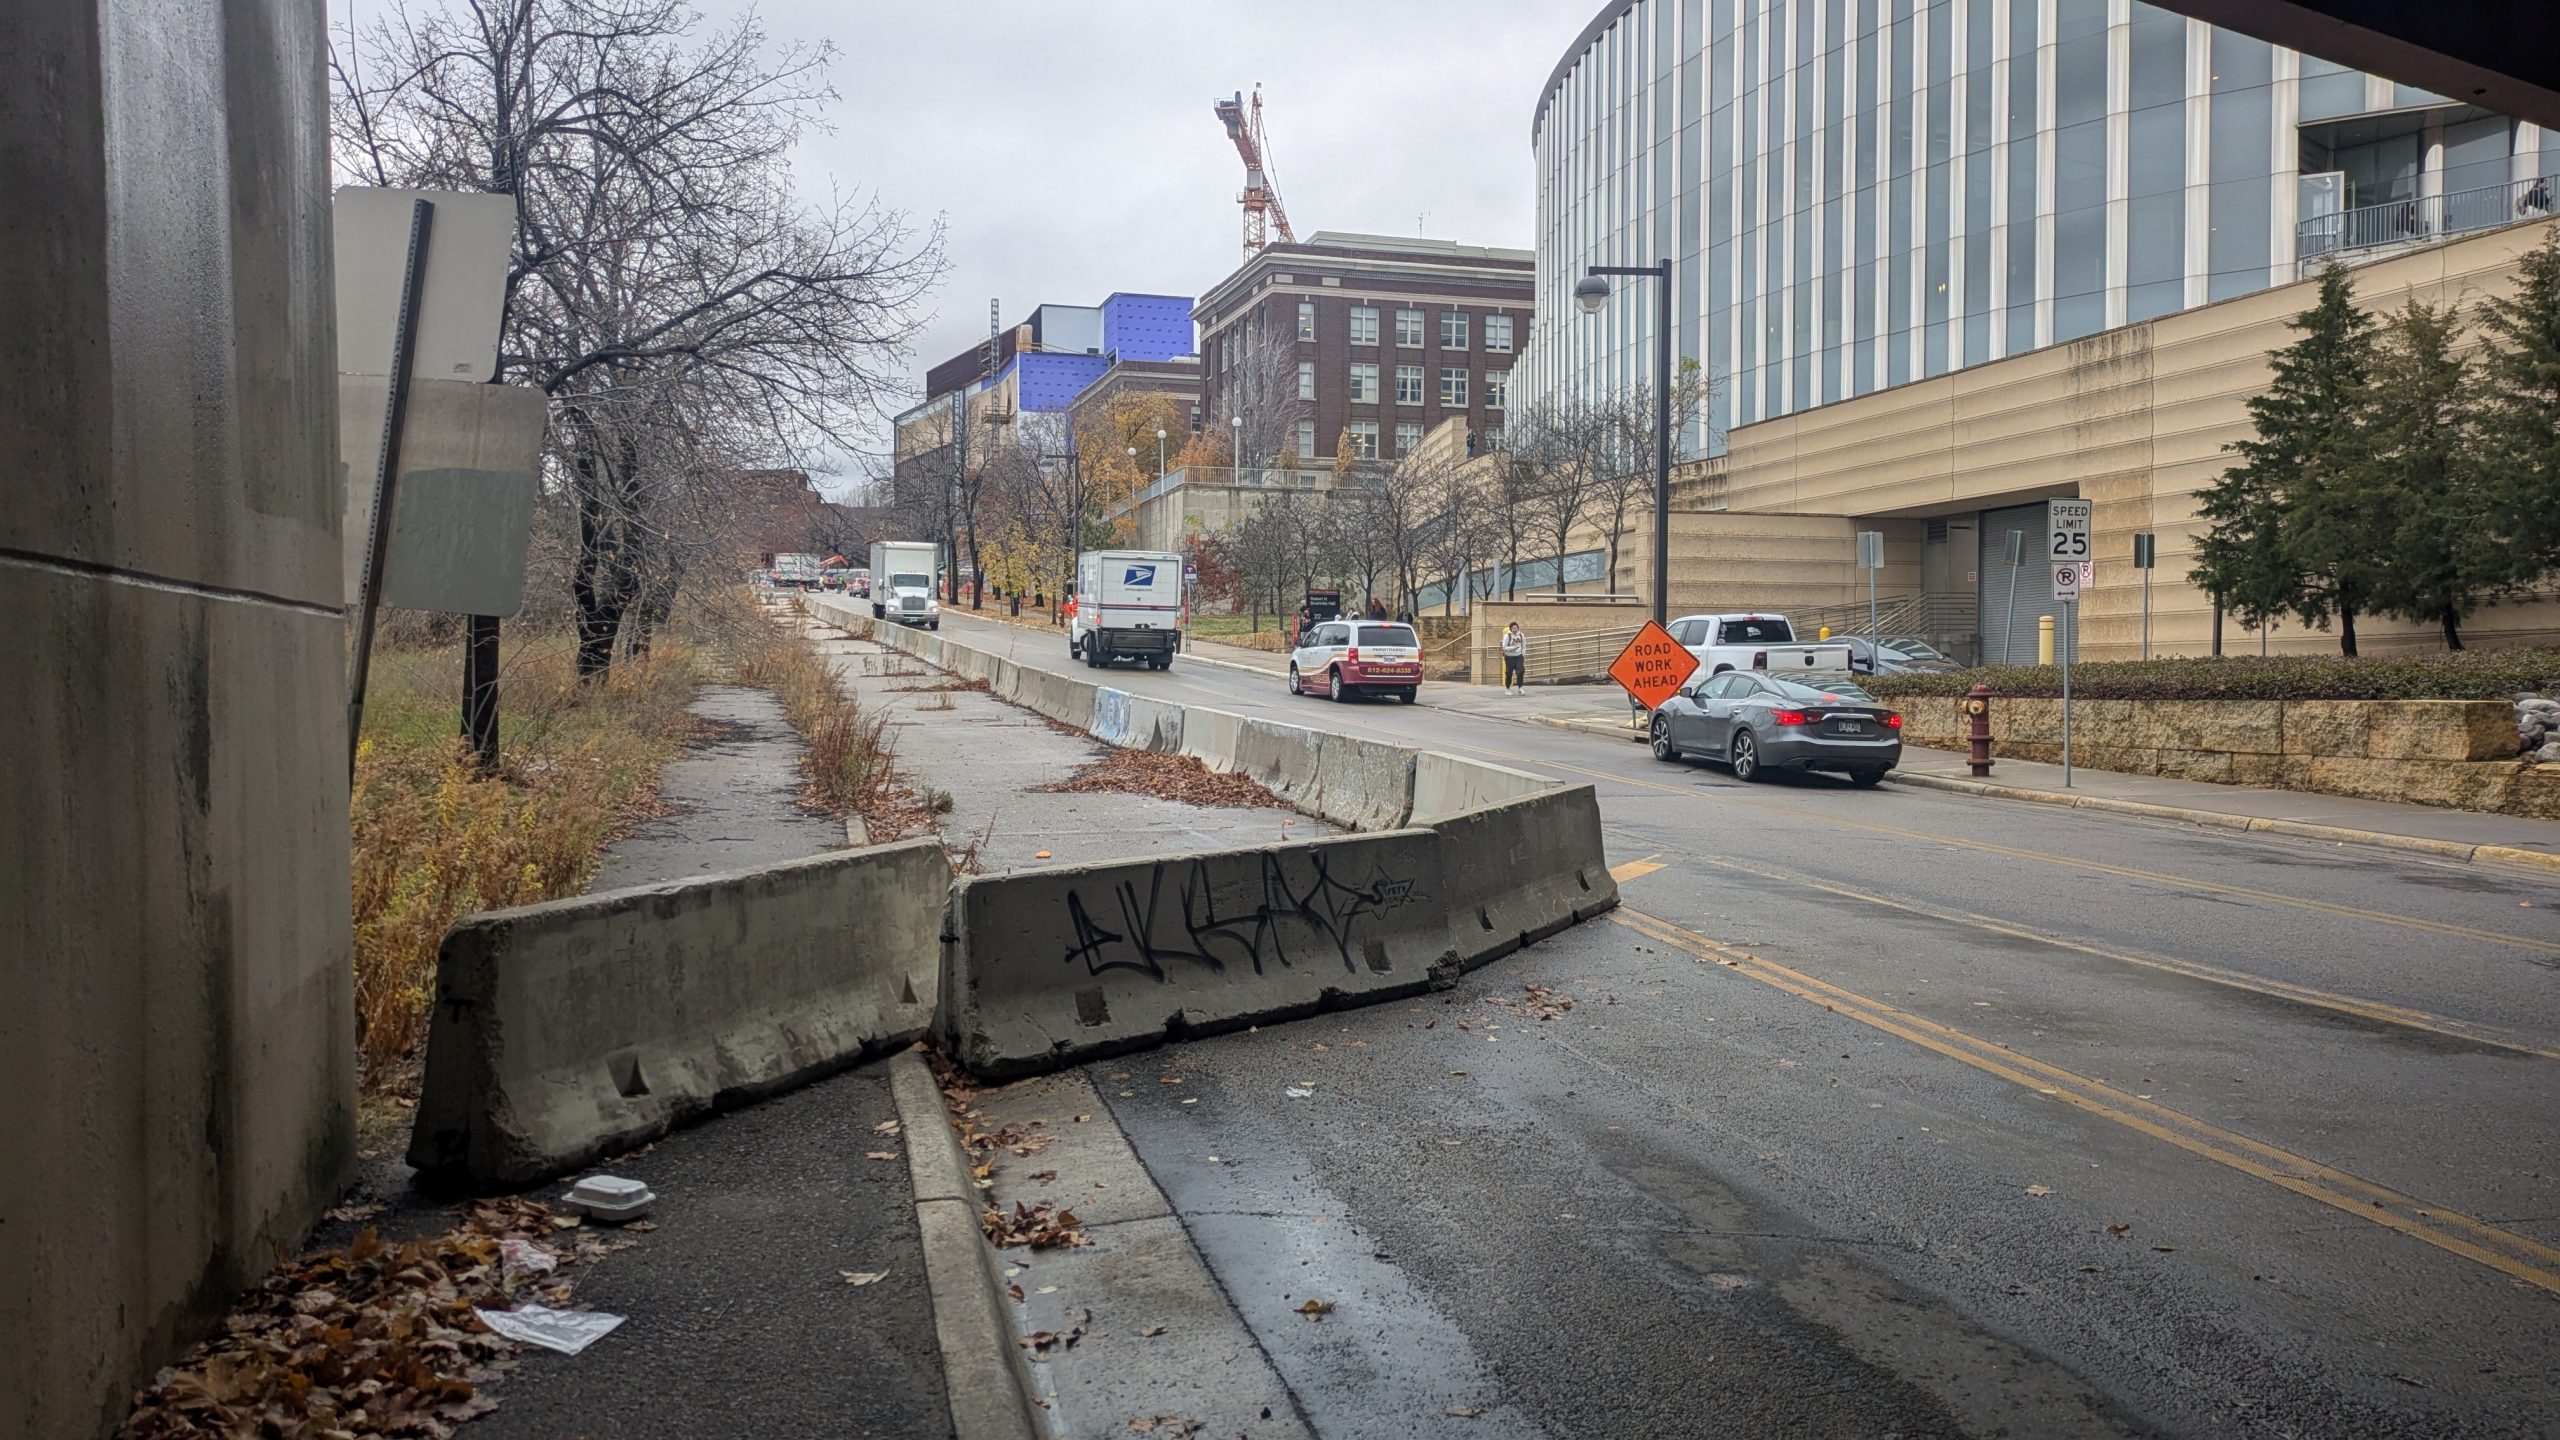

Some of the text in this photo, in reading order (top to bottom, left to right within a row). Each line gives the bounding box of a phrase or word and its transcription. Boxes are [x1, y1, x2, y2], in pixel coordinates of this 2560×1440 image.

[2053, 506, 2088, 516] SPEED
[2056, 519, 2083, 529] LIMIT
[2053, 532, 2087, 555] 25
[1635, 643, 1671, 656] ROAD
[1635, 659, 1672, 672] WORK
[1633, 675, 1678, 689] AHEAD
